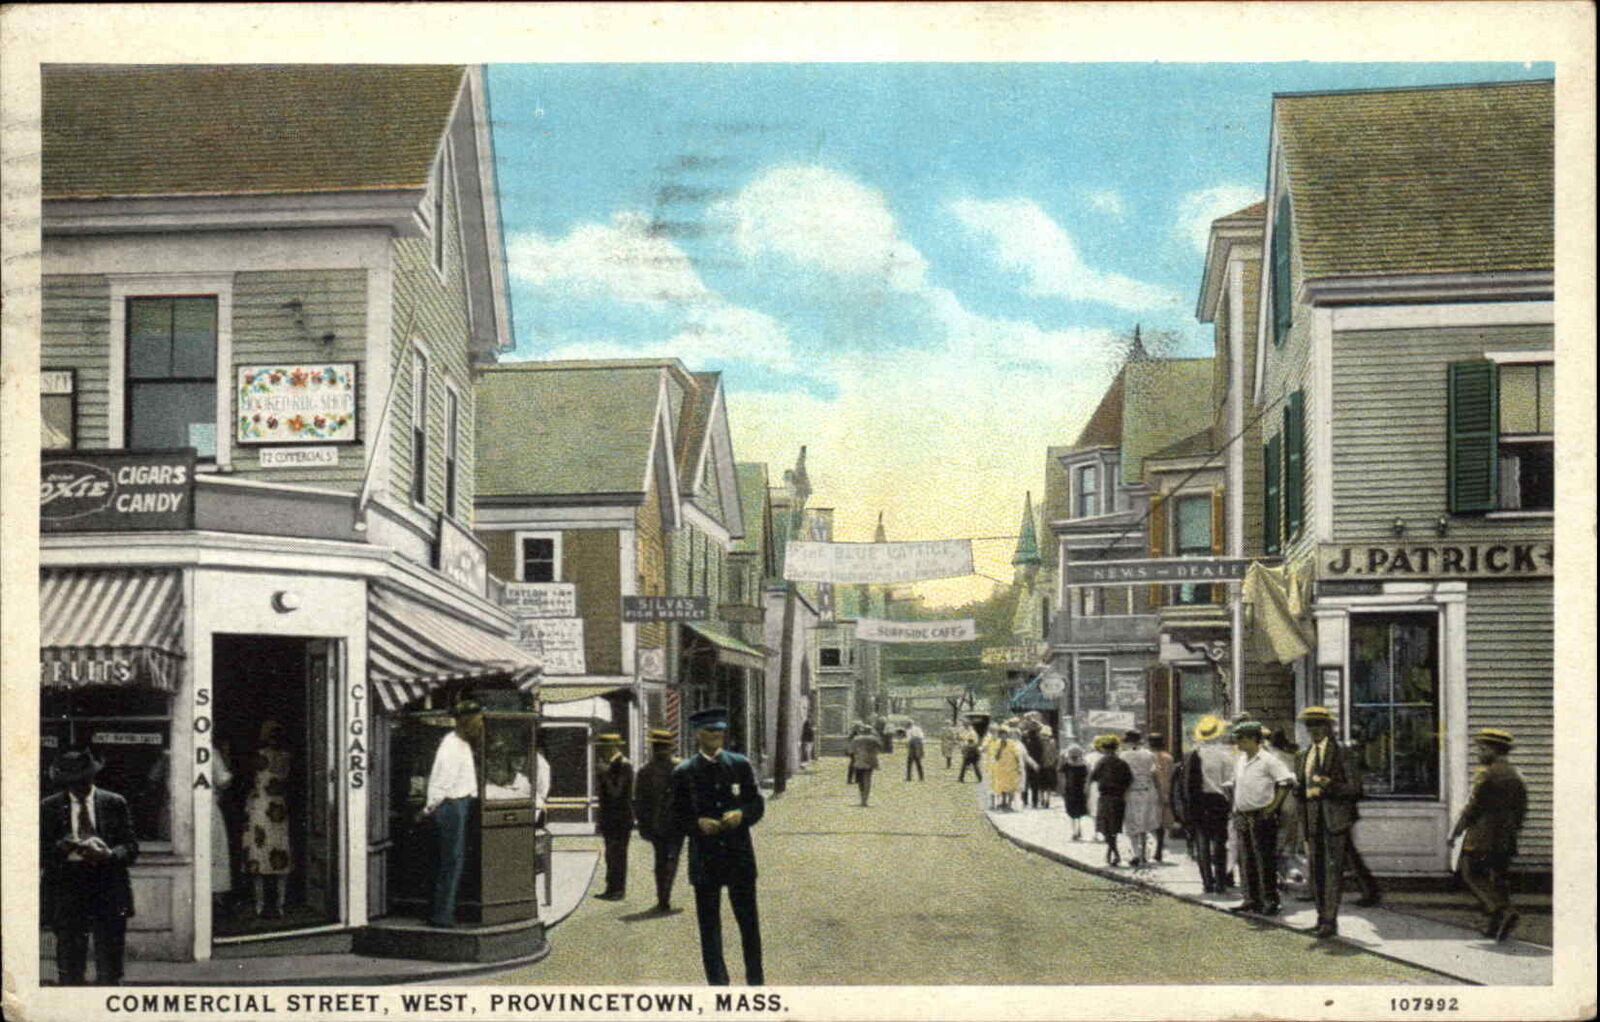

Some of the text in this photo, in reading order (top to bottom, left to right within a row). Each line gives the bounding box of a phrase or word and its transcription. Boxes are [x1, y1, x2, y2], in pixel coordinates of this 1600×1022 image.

[117, 465, 187, 485] CIGARS
[116, 492, 183, 513] CANDY
[1093, 567, 1147, 579] NEWS
[1177, 564, 1245, 577] DEALE
[658, 609, 705, 618] MARKET
[193, 688, 212, 790] SODA
[350, 683, 366, 789] CIGARS
